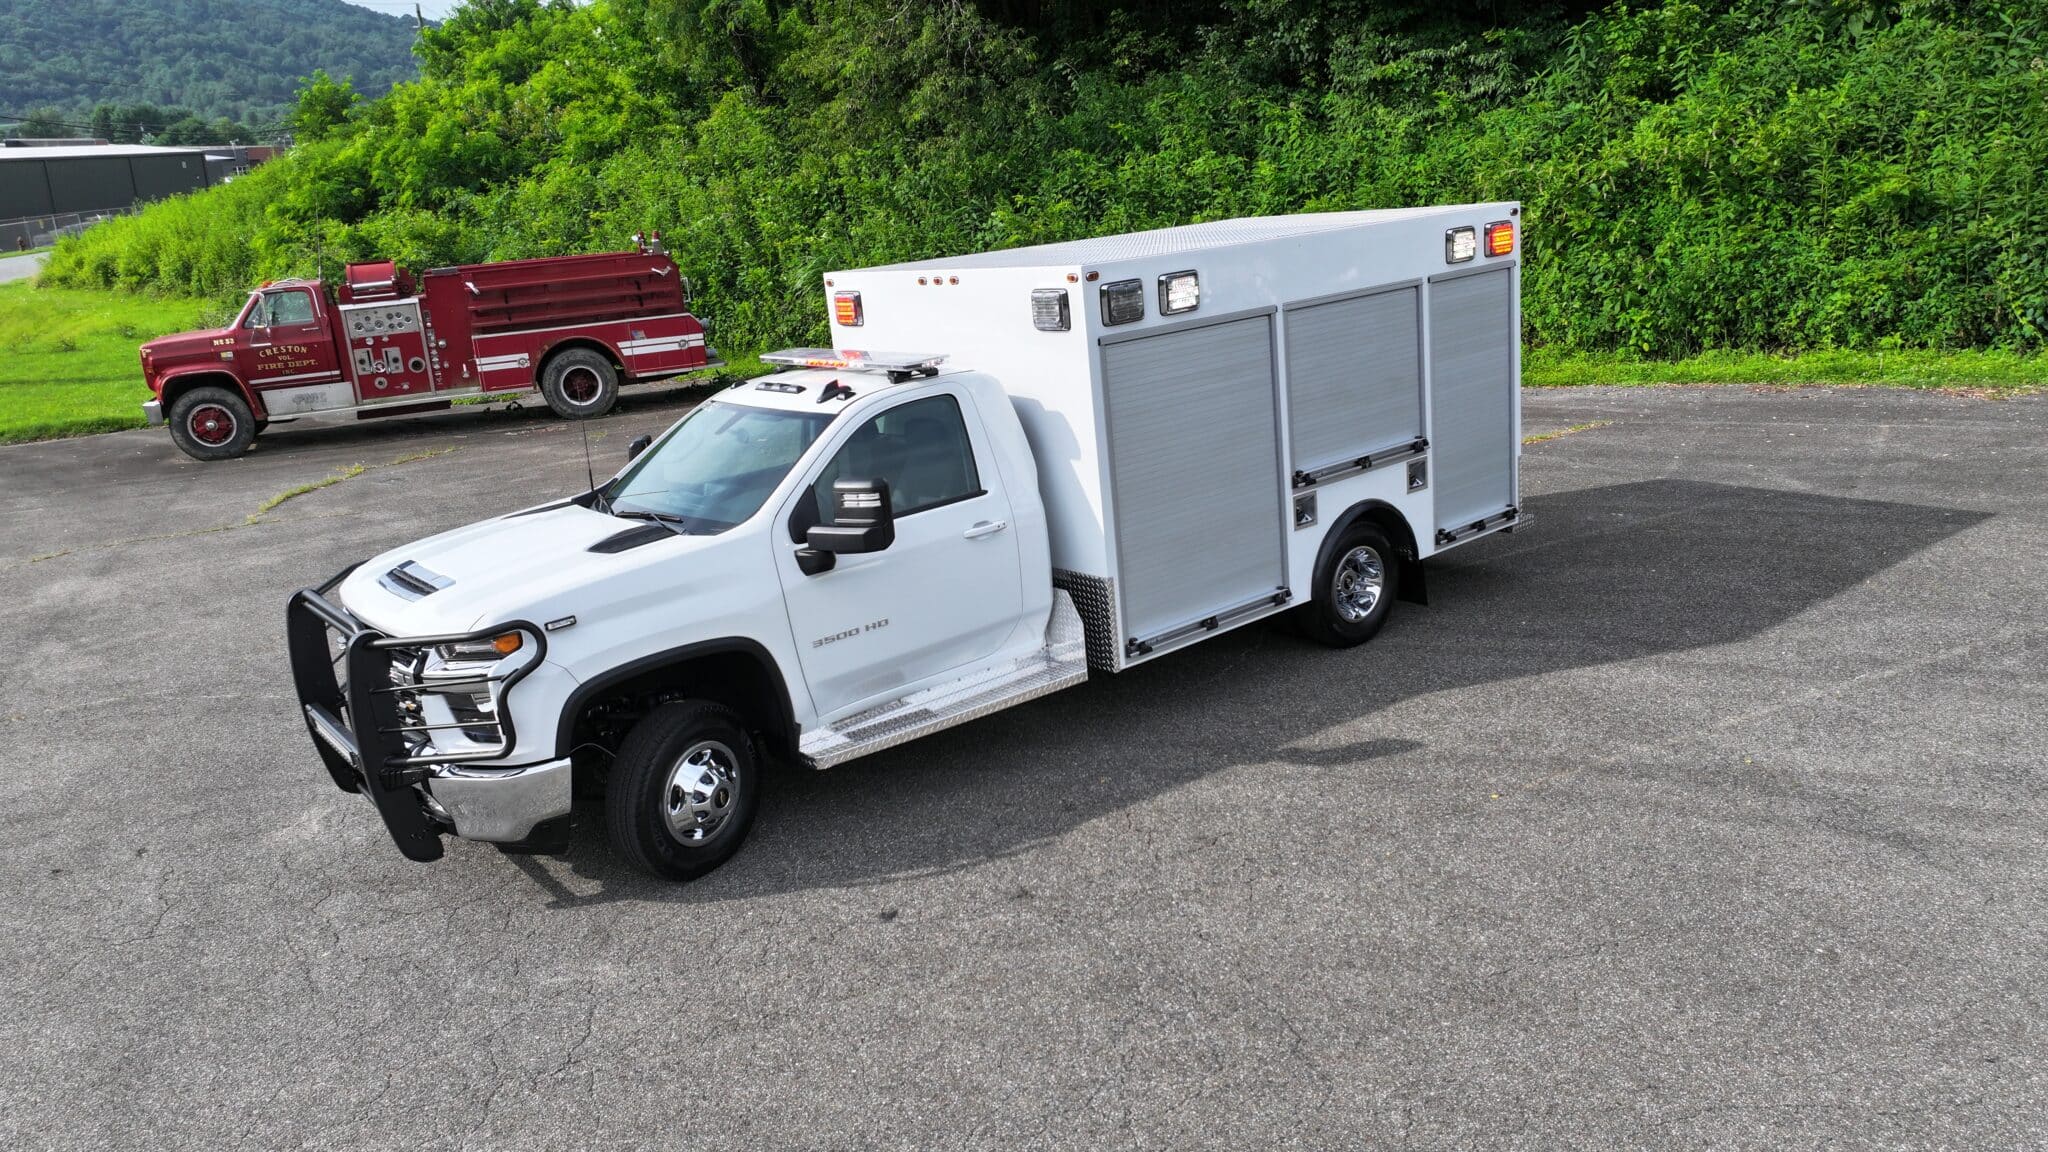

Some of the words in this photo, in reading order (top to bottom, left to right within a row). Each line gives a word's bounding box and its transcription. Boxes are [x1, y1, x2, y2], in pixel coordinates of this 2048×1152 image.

[259, 345, 308, 358] CRESTON
[257, 362, 285, 371] FIRE
[287, 359, 319, 368] DEPT.
[812, 627, 860, 649] 3500
[864, 618, 889, 632] HD
